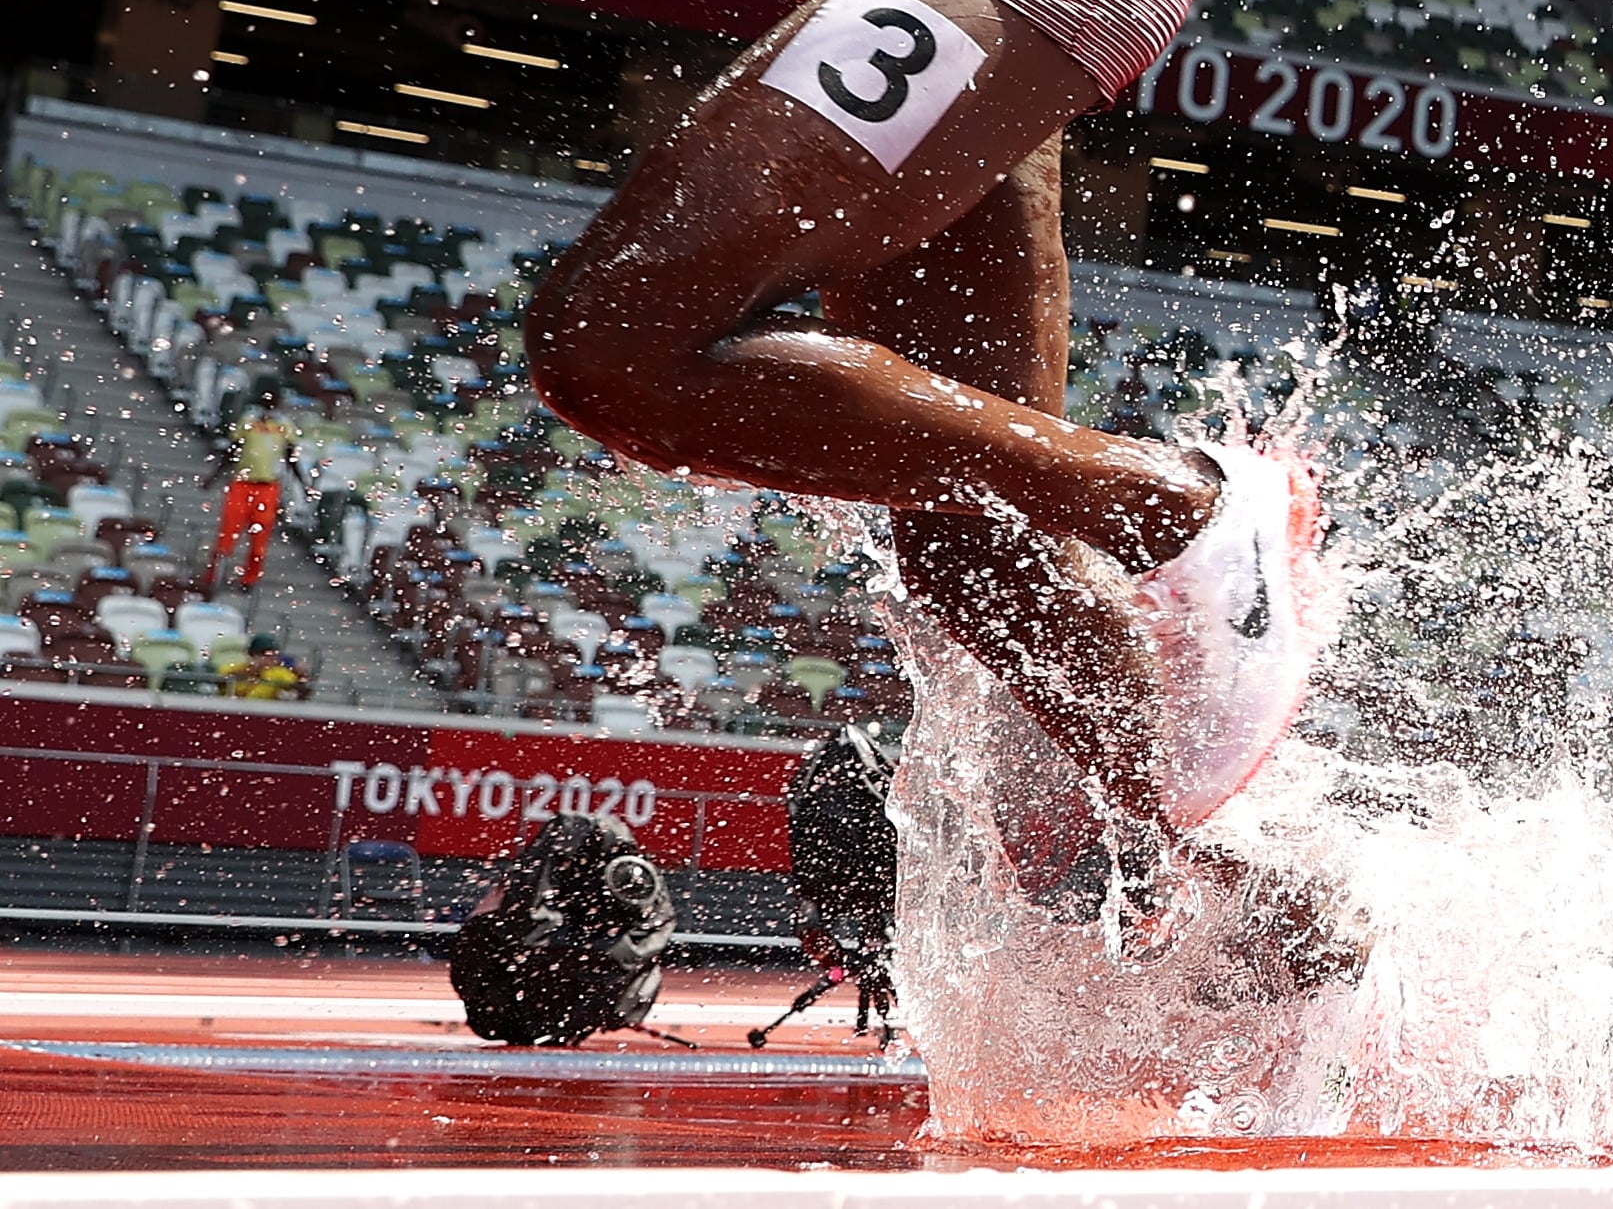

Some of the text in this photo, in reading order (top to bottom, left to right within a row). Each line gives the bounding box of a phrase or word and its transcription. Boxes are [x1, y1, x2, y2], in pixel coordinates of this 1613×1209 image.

[818, 7, 937, 123] 3
[1250, 59, 1458, 159] 2020
[330, 760, 657, 827] TOKYO 2020
